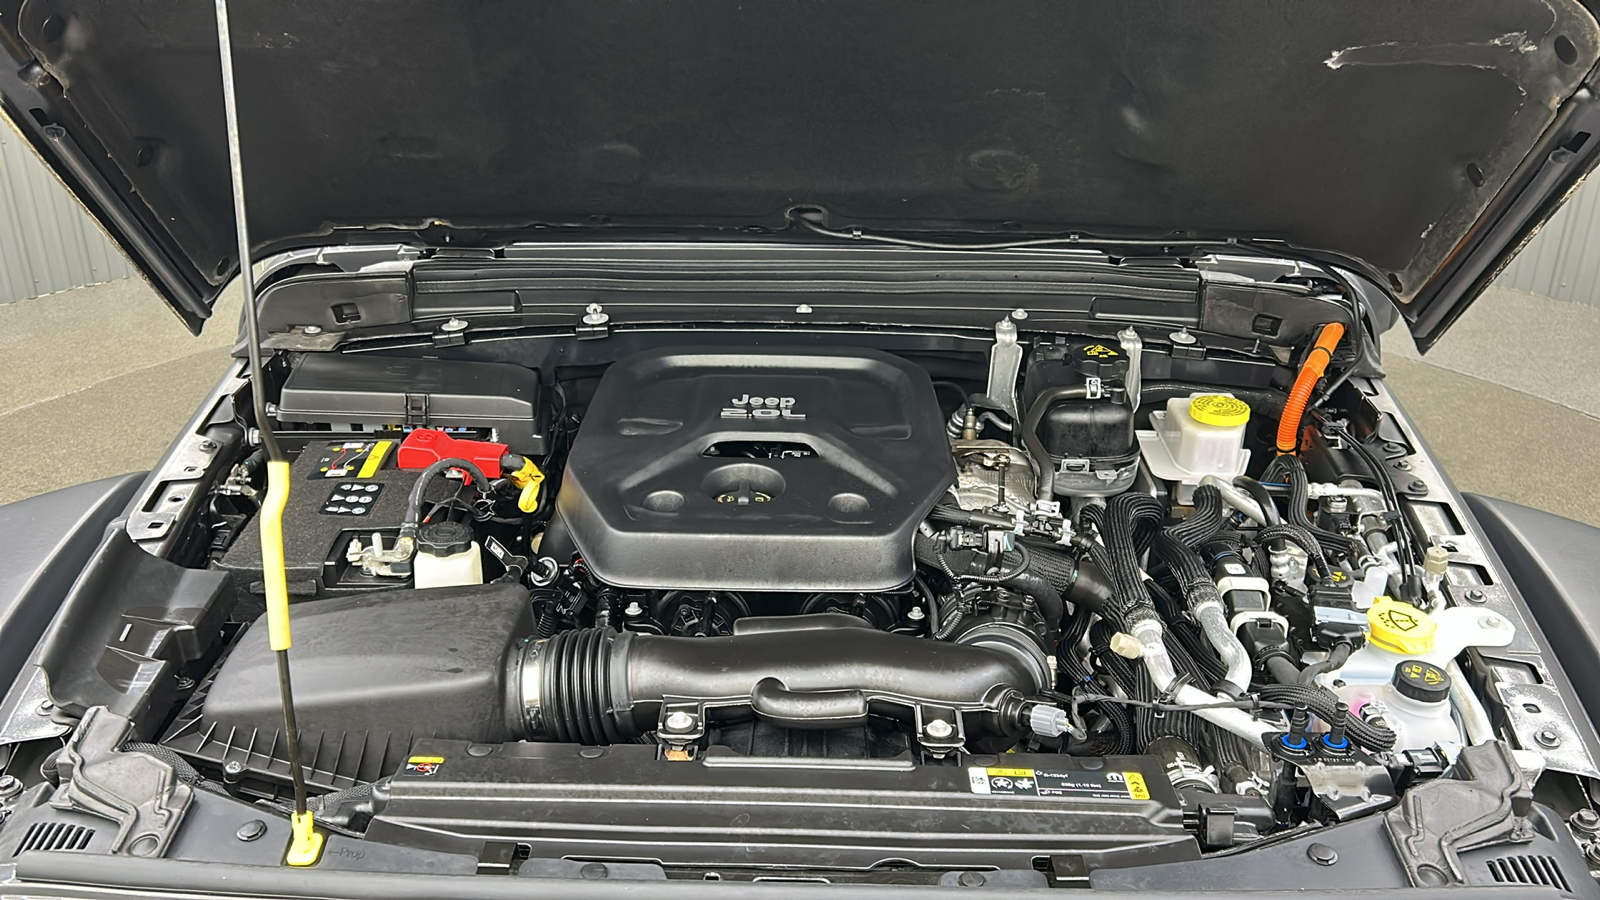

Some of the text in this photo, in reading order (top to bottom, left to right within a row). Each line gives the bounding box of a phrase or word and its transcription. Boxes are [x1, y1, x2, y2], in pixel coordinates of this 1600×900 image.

[731, 394, 796, 408] Jeep
[720, 407, 807, 419] 2.0L
[339, 846, 366, 861] Prop
